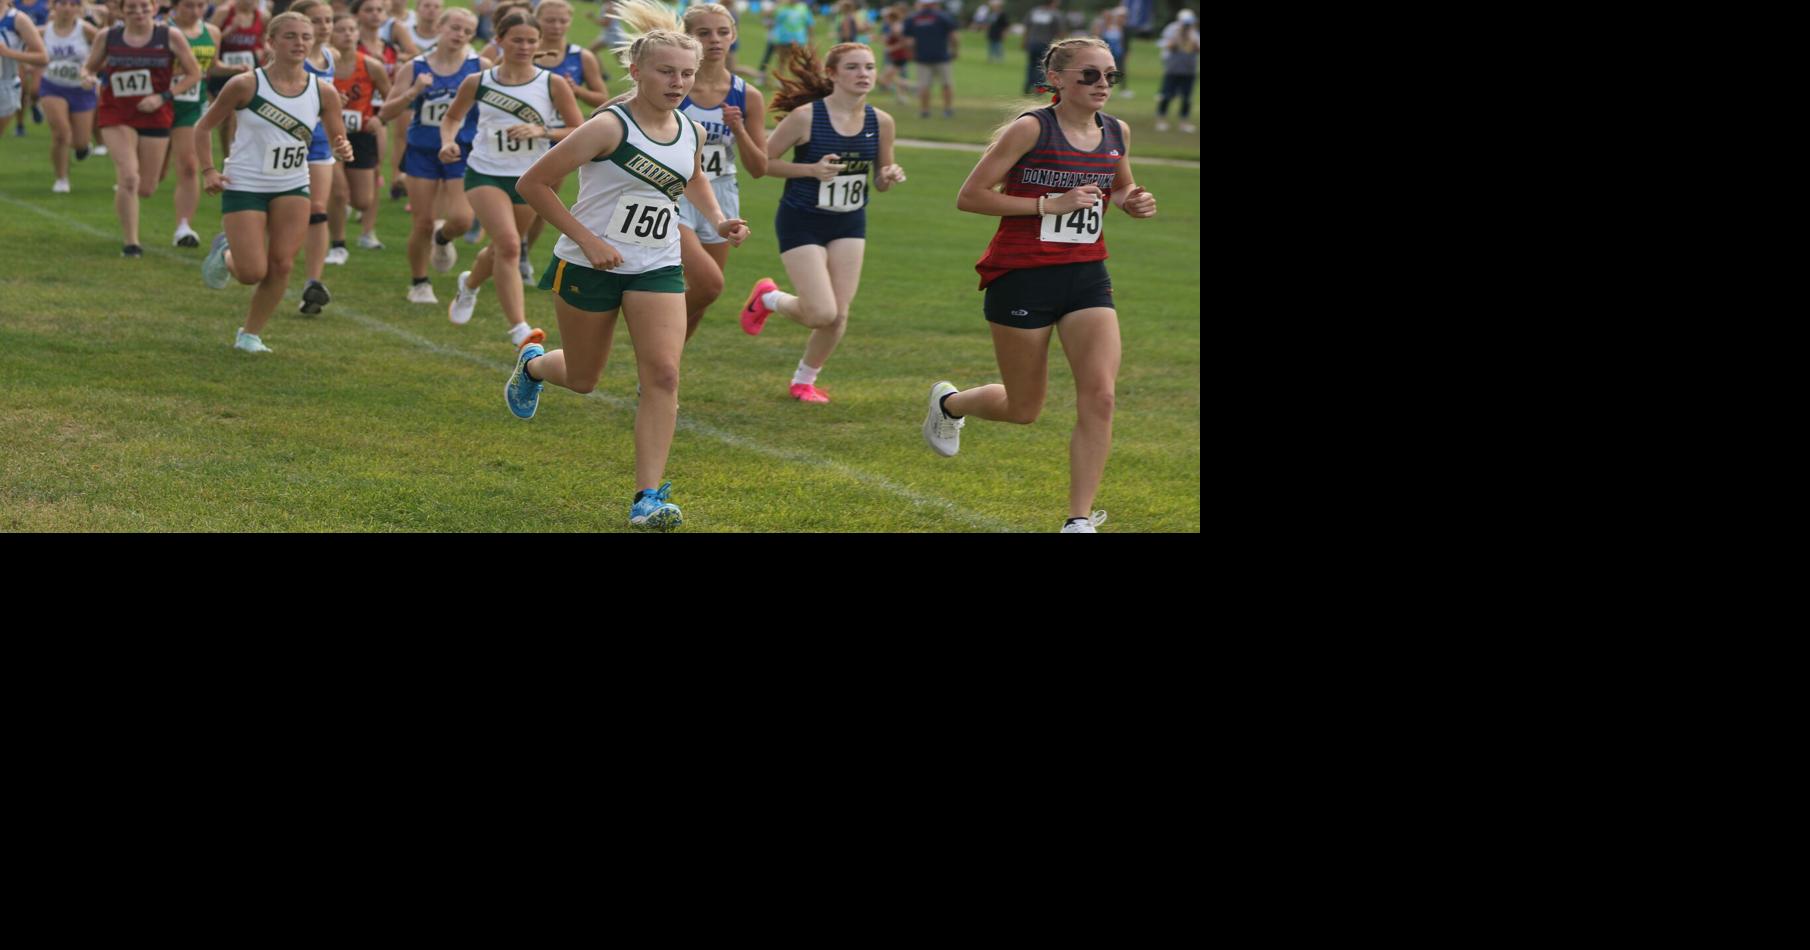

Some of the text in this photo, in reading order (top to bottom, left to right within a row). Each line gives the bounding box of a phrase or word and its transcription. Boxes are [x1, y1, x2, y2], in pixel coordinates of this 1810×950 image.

[117, 73, 148, 92] 147
[428, 103, 449, 121] 12
[701, 120, 731, 136] UTH
[495, 130, 533, 152] 151
[272, 146, 305, 170] 155
[628, 154, 675, 187] KEARNEY
[701, 150, 722, 176] 4
[827, 180, 863, 207] 118
[620, 203, 671, 240] 150
[1054, 201, 1099, 234] 145
